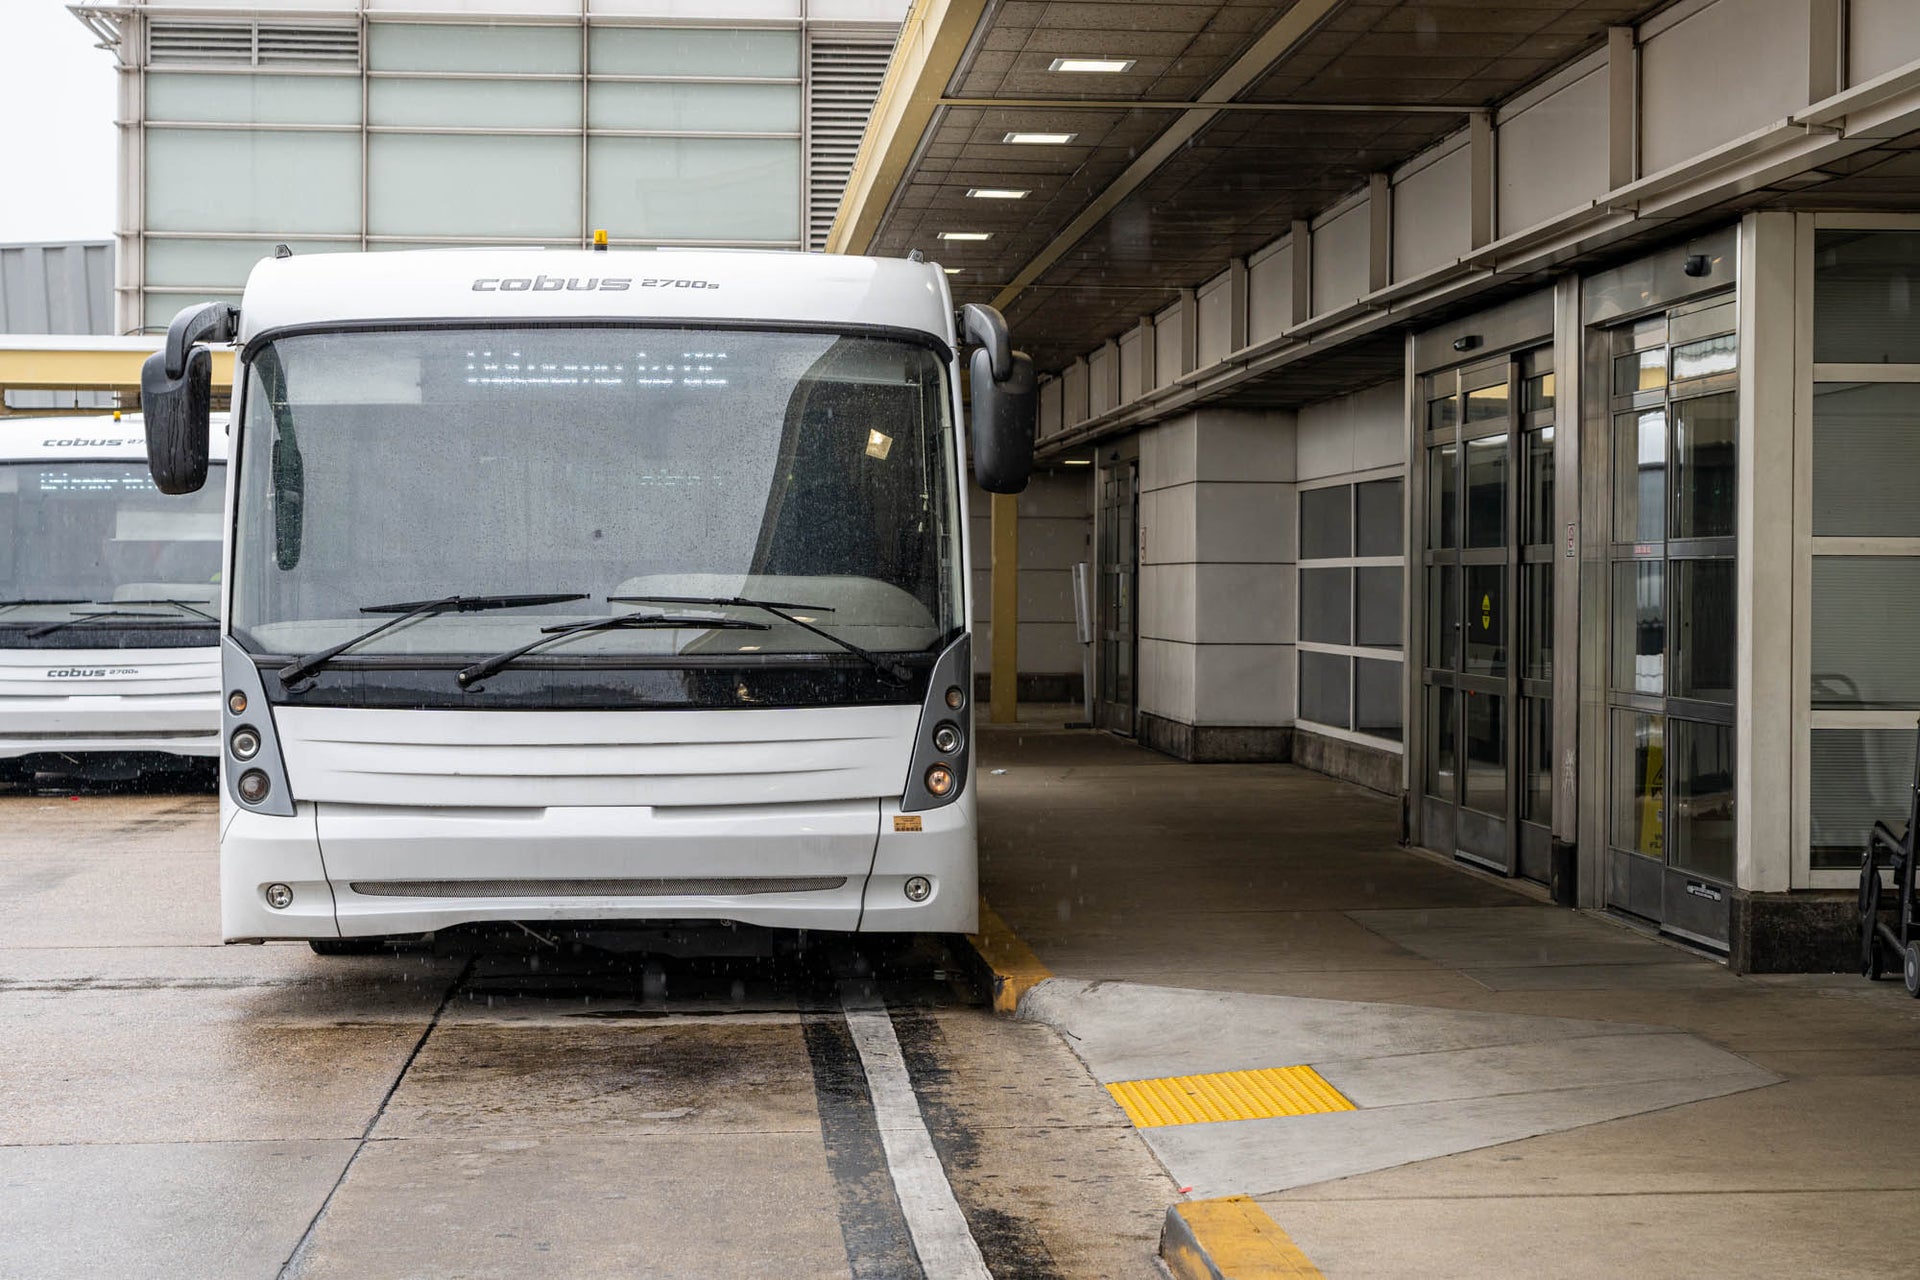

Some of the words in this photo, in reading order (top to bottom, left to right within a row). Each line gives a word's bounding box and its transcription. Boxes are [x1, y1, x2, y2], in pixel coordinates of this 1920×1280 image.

[472, 275, 632, 291] cobus
[641, 278, 719, 289] 2700s
[43, 438, 122, 446] cobus
[47, 668, 106, 677] cobus
